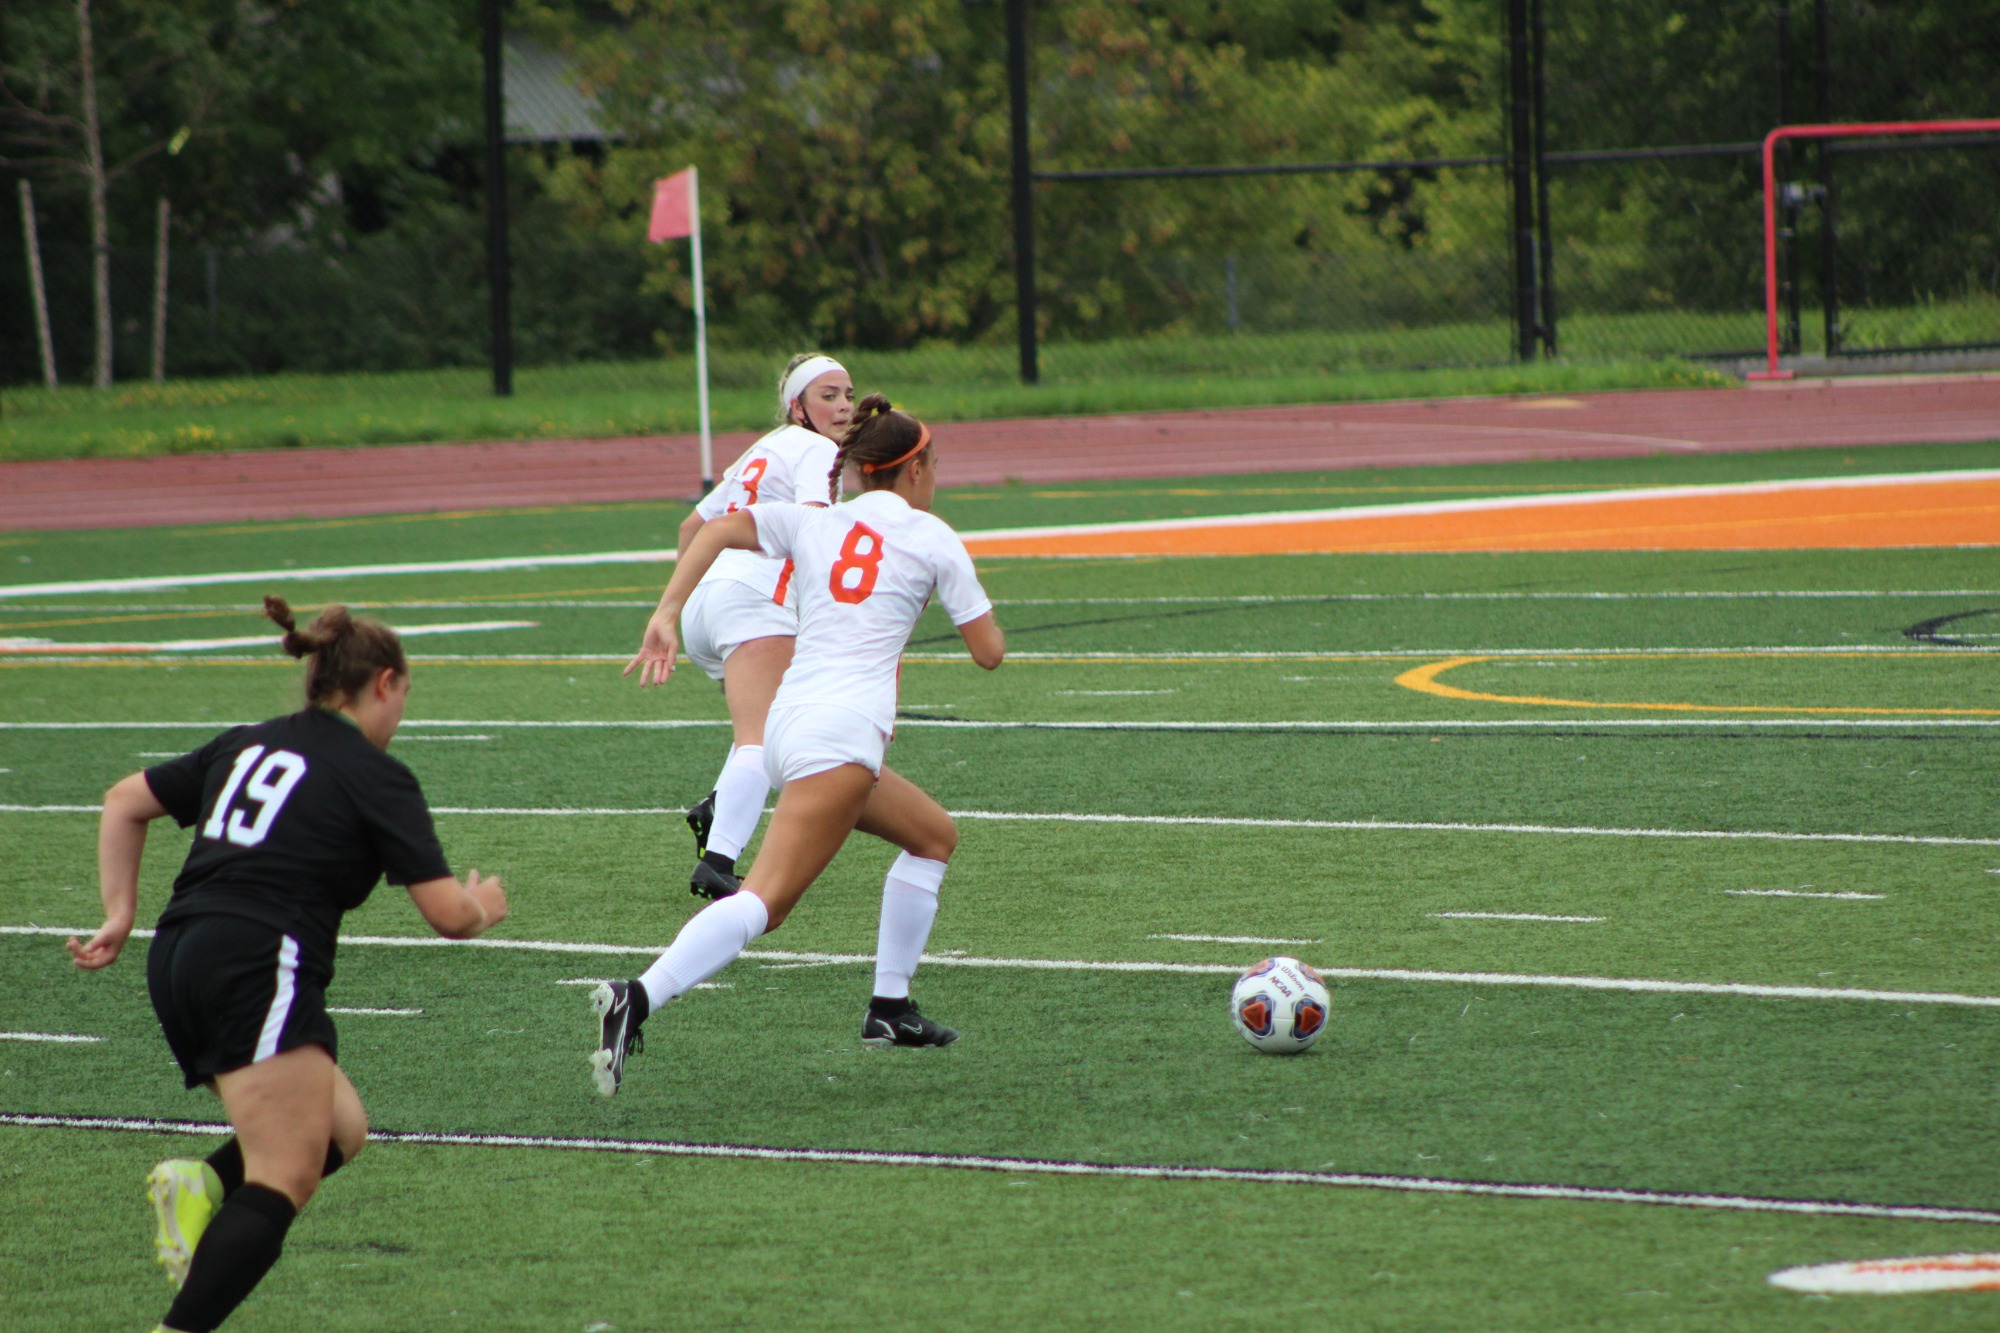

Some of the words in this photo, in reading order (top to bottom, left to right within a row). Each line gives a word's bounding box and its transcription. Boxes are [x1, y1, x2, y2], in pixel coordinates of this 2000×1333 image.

[727, 457, 768, 513] 3
[829, 521, 884, 605] 8
[202, 744, 307, 847] 19
[1269, 976, 1293, 998] NCAA
[1281, 966, 1305, 992] Wilson
